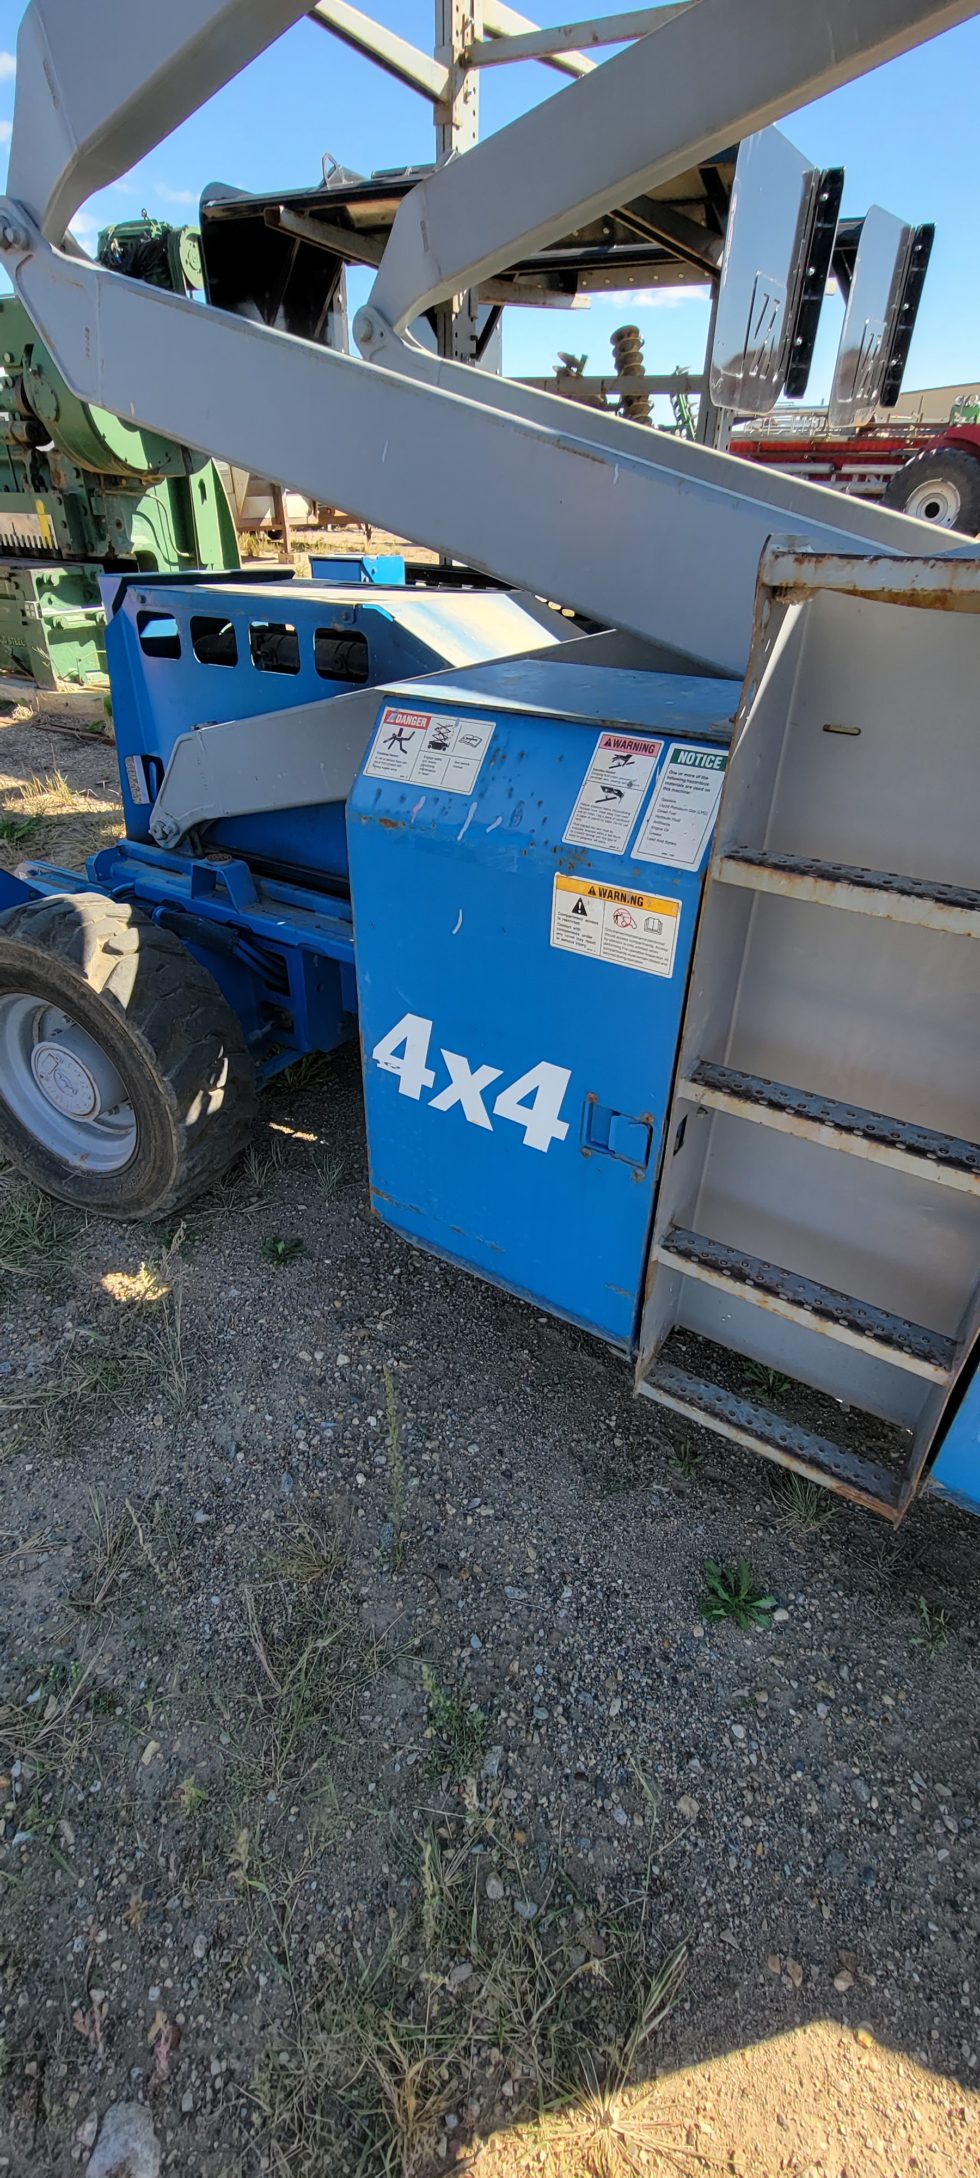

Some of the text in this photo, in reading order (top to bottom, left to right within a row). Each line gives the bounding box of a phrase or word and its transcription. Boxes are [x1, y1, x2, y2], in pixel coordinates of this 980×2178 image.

[396, 714, 428, 727] DANGER
[613, 738, 656, 754] WARNING
[678, 751, 723, 769] NOTICE
[598, 887, 644, 907] WARNNG
[373, 1013, 572, 1153] 4x4
